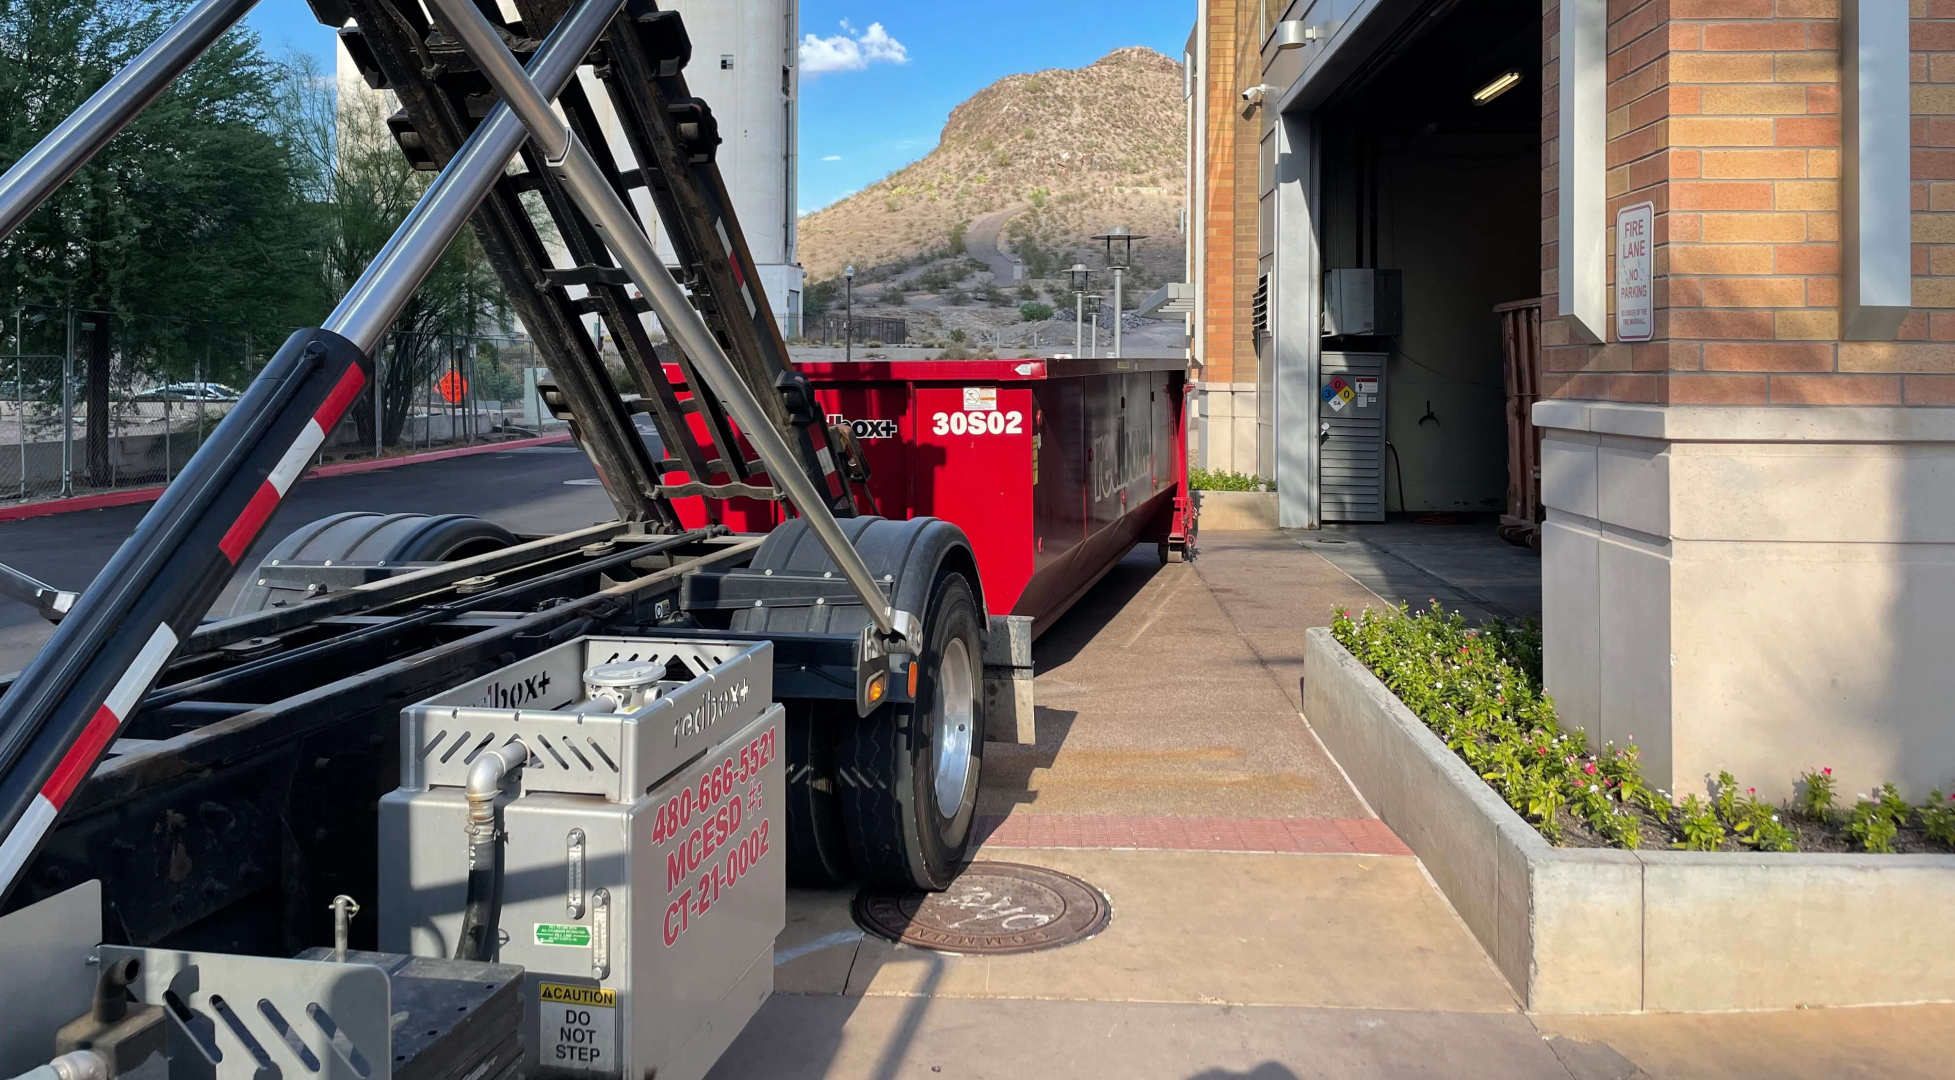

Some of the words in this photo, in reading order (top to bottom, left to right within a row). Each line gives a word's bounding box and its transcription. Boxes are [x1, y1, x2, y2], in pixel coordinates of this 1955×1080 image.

[1625, 219, 1644, 238] FIRE
[1623, 240, 1646, 259] LANE
[1629, 268, 1638, 281] NO
[1621, 285, 1647, 299] PARKING
[1325, 390, 1331, 398] 3
[1335, 381, 1341, 389] 0
[1344, 391, 1350, 399] 0
[932, 411, 1023, 436] 30S02
[674, 678, 750, 748] redbox+
[652, 725, 776, 847] 480-666-5521
[667, 794, 743, 895] MCESD
[663, 817, 770, 948] CT-21-0002
[553, 987, 613, 1004] CAUTION
[566, 1009, 591, 1026] DO
[560, 1026, 596, 1044] NOT
[555, 1044, 600, 1062] STEP
